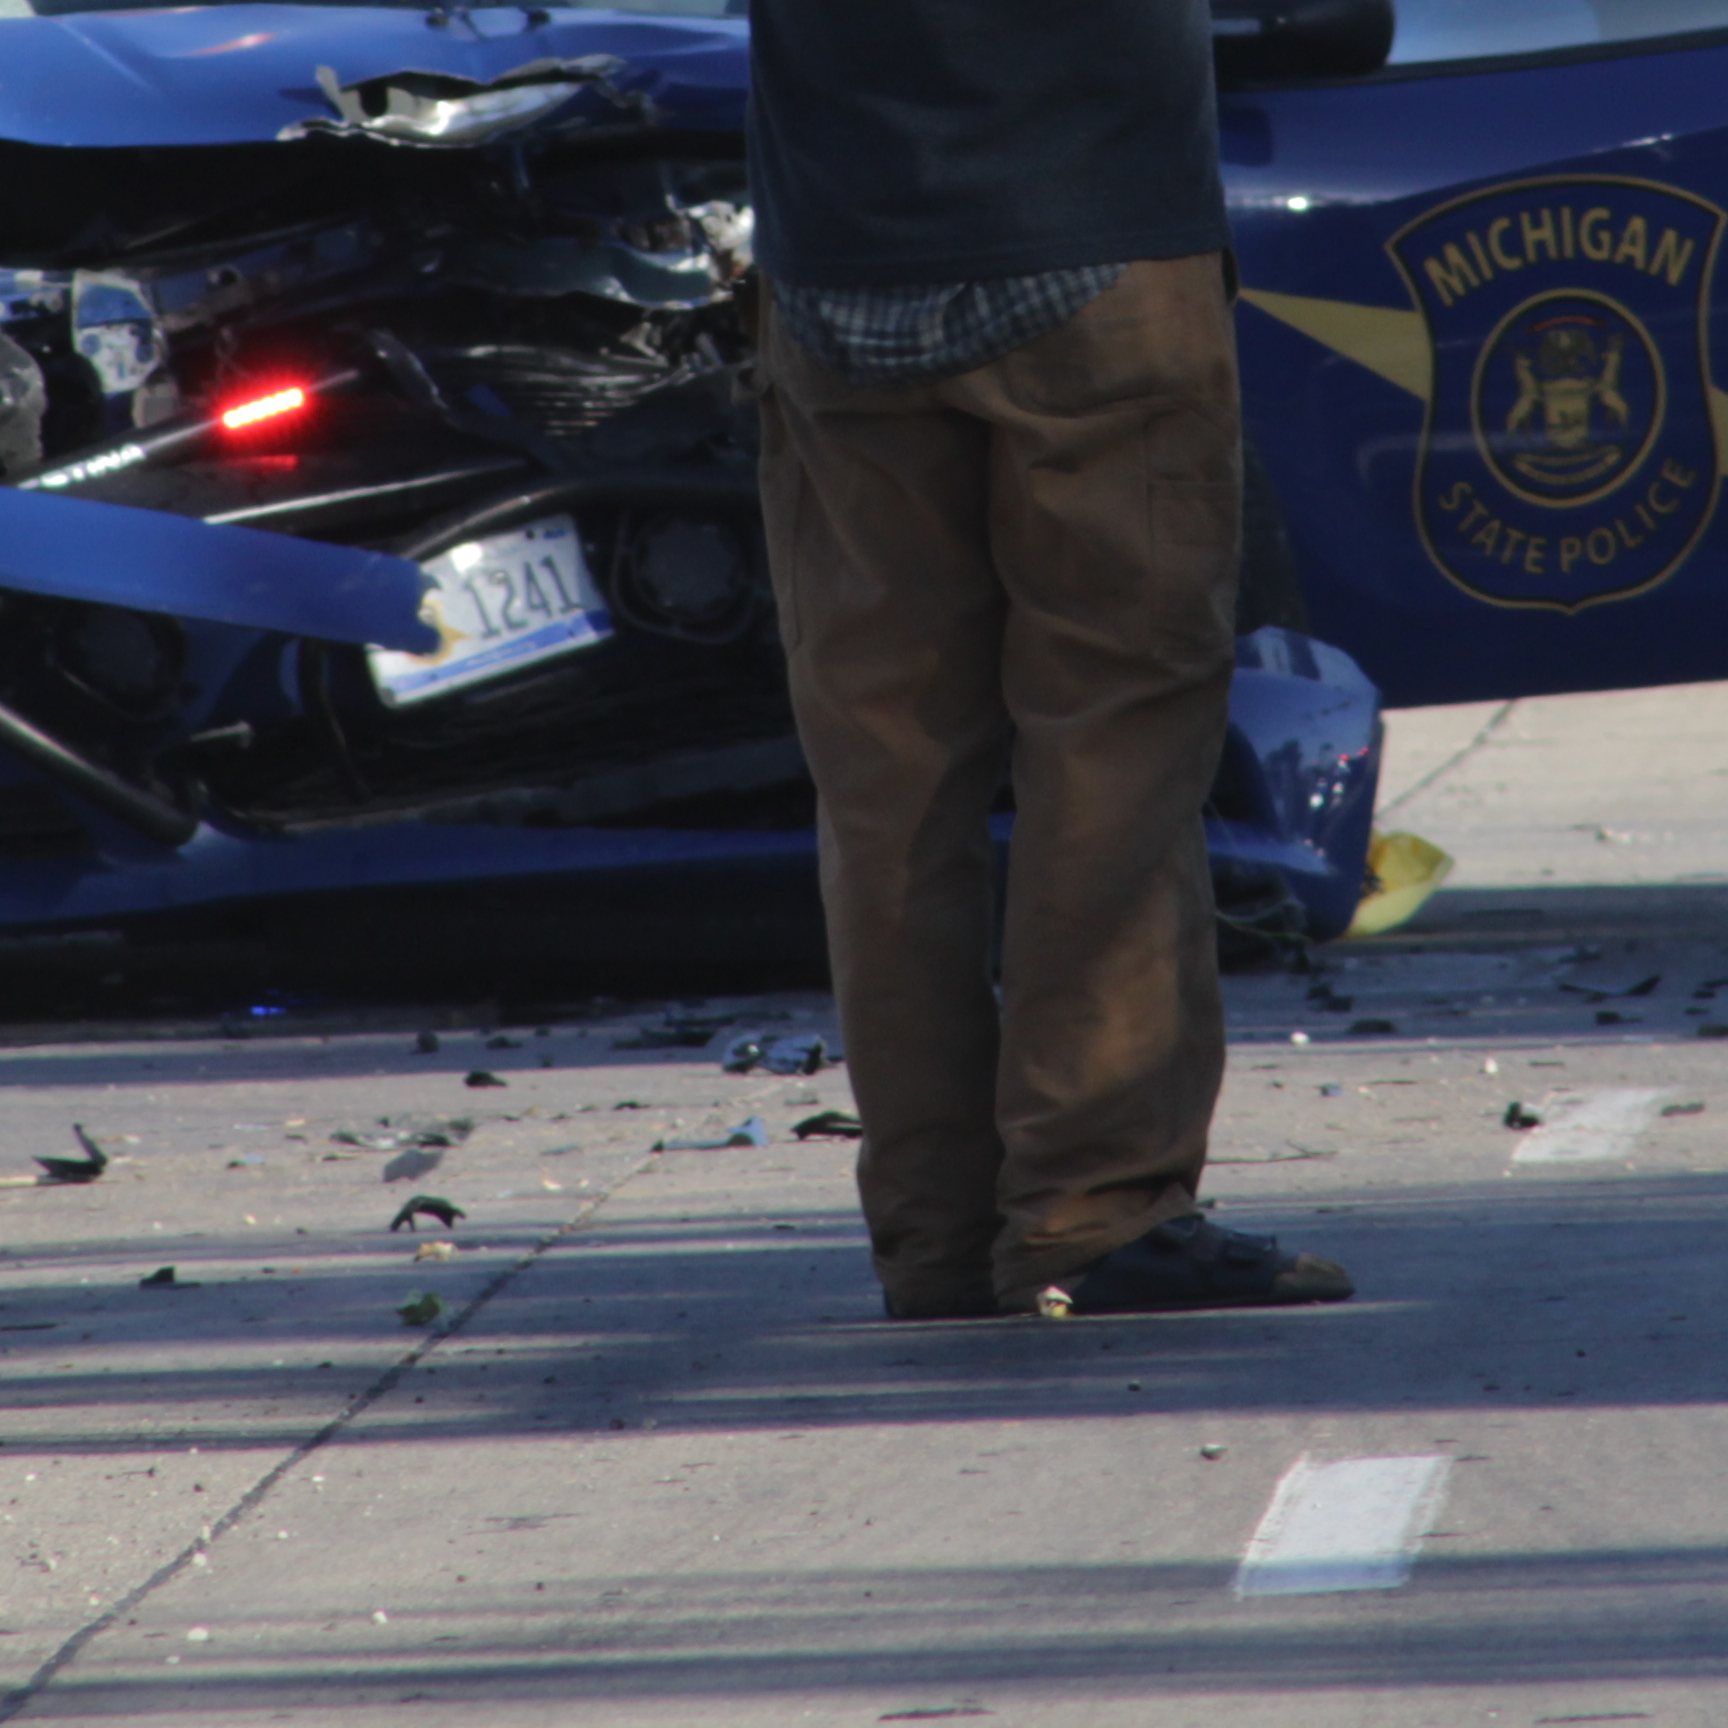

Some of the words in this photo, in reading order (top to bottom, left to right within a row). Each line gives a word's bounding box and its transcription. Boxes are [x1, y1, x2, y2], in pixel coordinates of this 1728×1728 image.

[1424, 205, 1694, 308] MICHIGAN
[1438, 480, 1548, 574] STATE
[1560, 457, 1696, 574] POLICE
[464, 555, 584, 639] 1241
